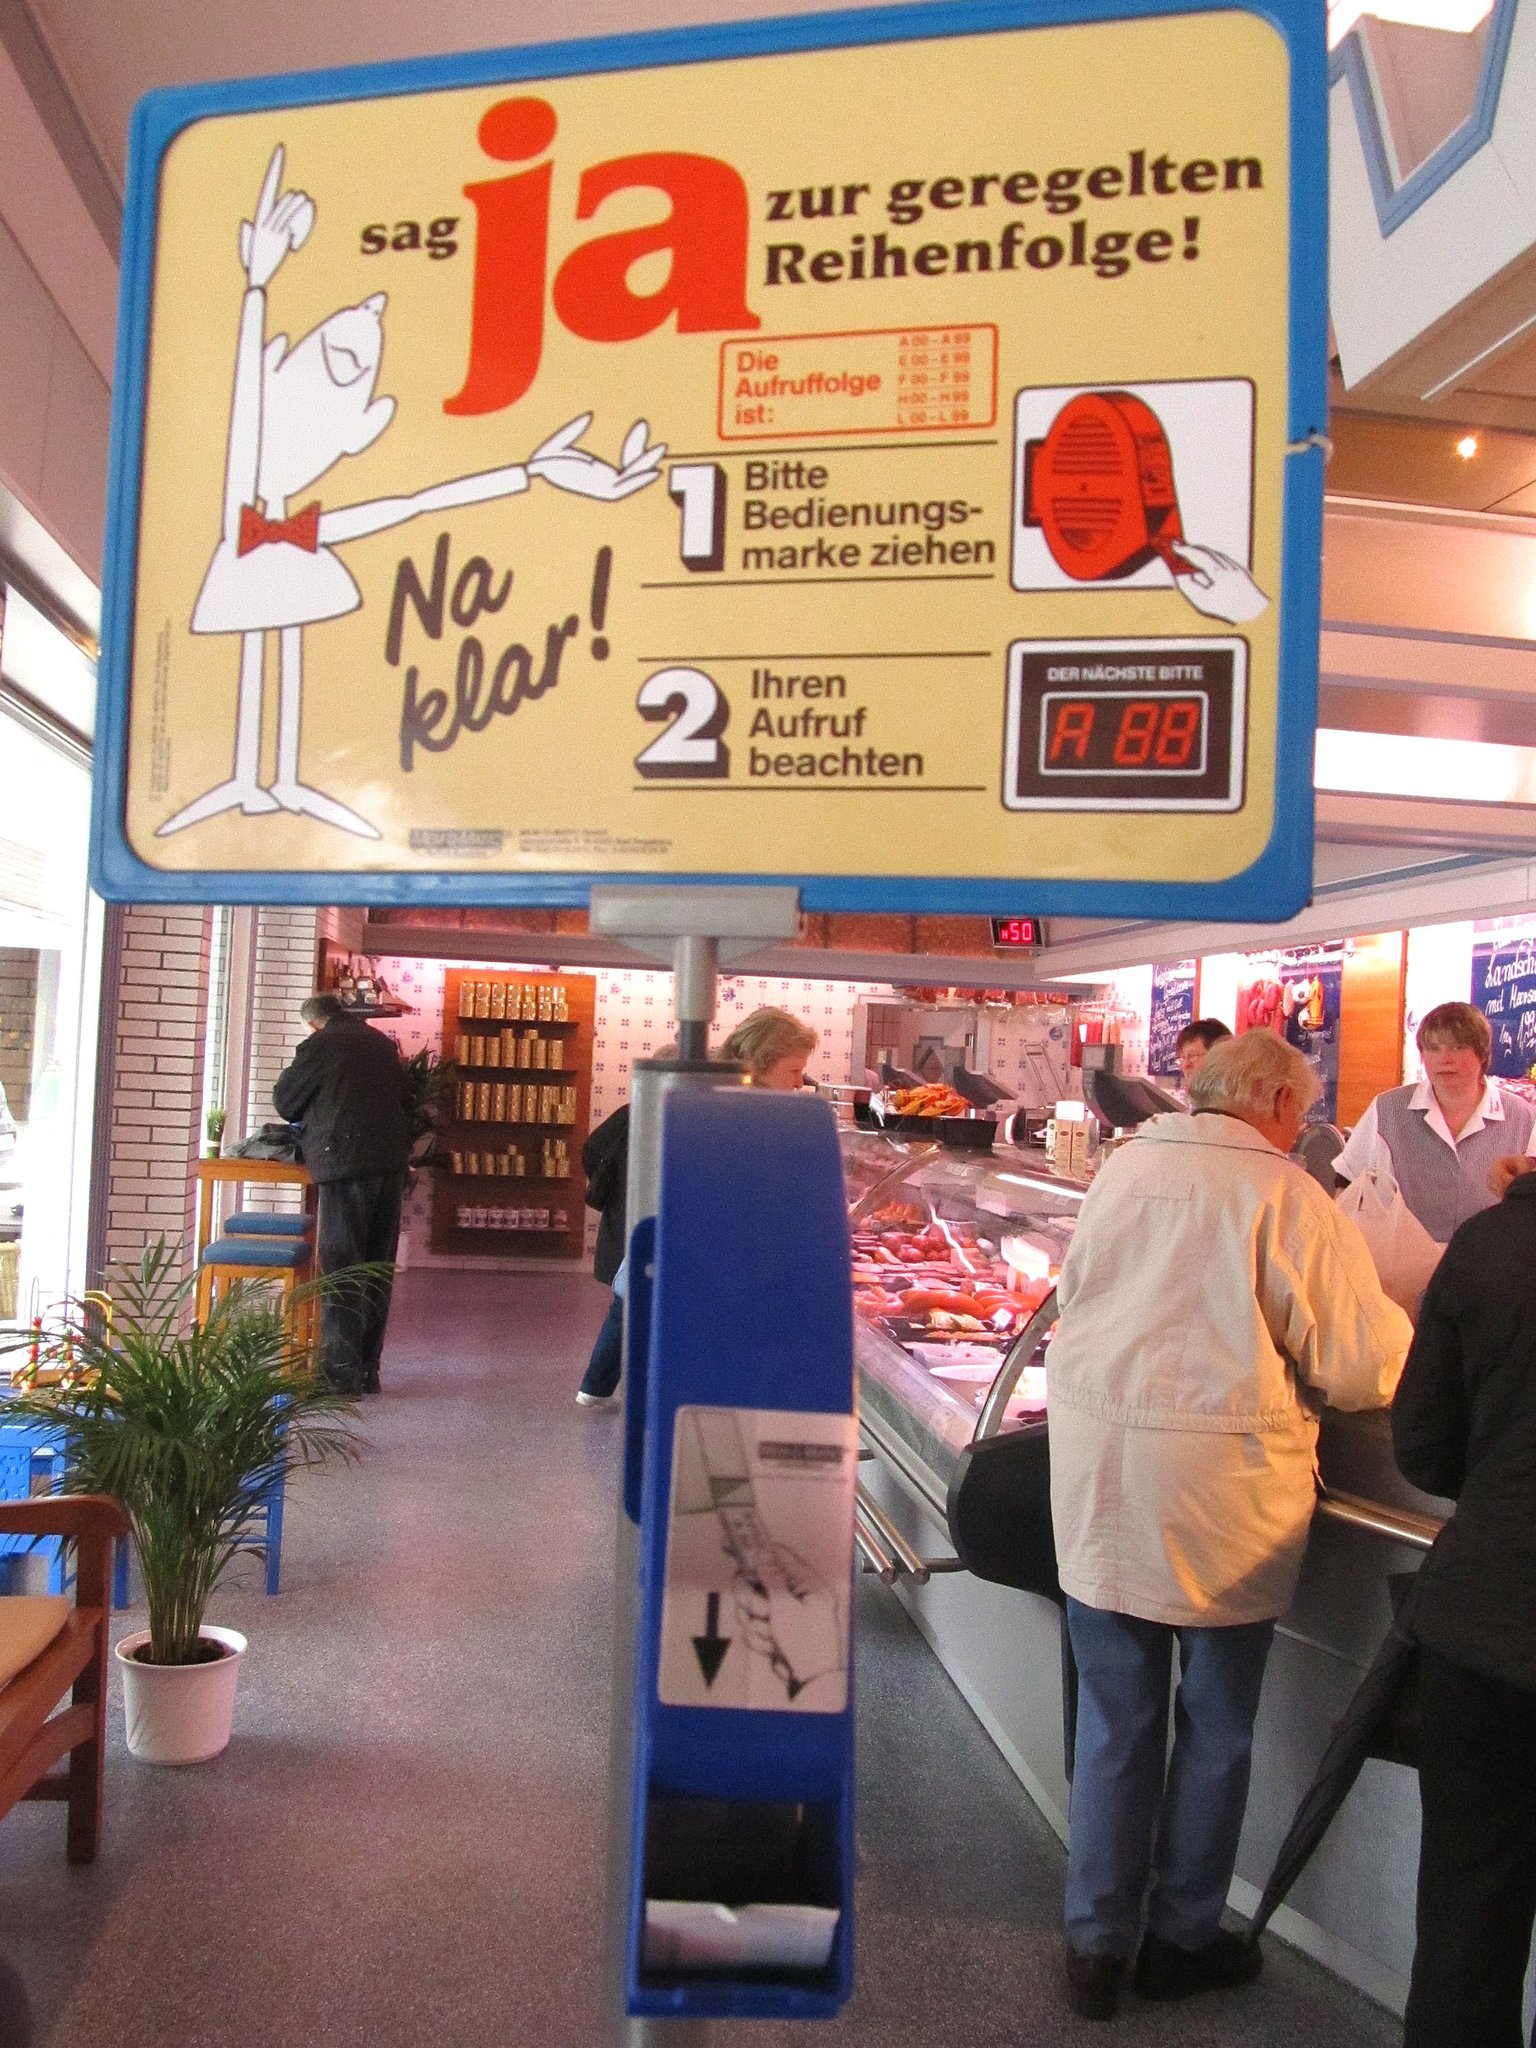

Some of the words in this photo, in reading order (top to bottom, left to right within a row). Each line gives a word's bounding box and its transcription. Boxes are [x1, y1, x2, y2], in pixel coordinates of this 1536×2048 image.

[360, 216, 460, 260] sag
[443, 97, 762, 417] ja
[765, 182, 871, 223] zur
[886, 149, 1264, 225] geregelten
[764, 217, 1200, 285] Reihenfolge!
[737, 351, 779, 372] Die
[735, 370, 881, 398] Aufruffolge
[735, 403, 774, 425] ist:
[745, 461, 829, 492] Bitte
[667, 463, 728, 573] 1
[743, 498, 983, 532] Bedienungs-
[742, 537, 861, 570] marke
[870, 534, 996, 567] ziehen
[384, 531, 514, 668] Na
[399, 544, 614, 773] klar!
[1047, 667, 1080, 682] DER
[1082, 664, 1156, 681] NÄCHSTE
[1159, 665, 1203, 680] BITTE
[751, 668, 847, 699] Ihren
[634, 666, 730, 779] 2
[748, 706, 867, 739] Aufruf
[1050, 703, 1095, 763] A
[1113, 702, 1199, 765] 88
[749, 745, 924, 778] beachten
[1485, 941, 1536, 988] Landsch
